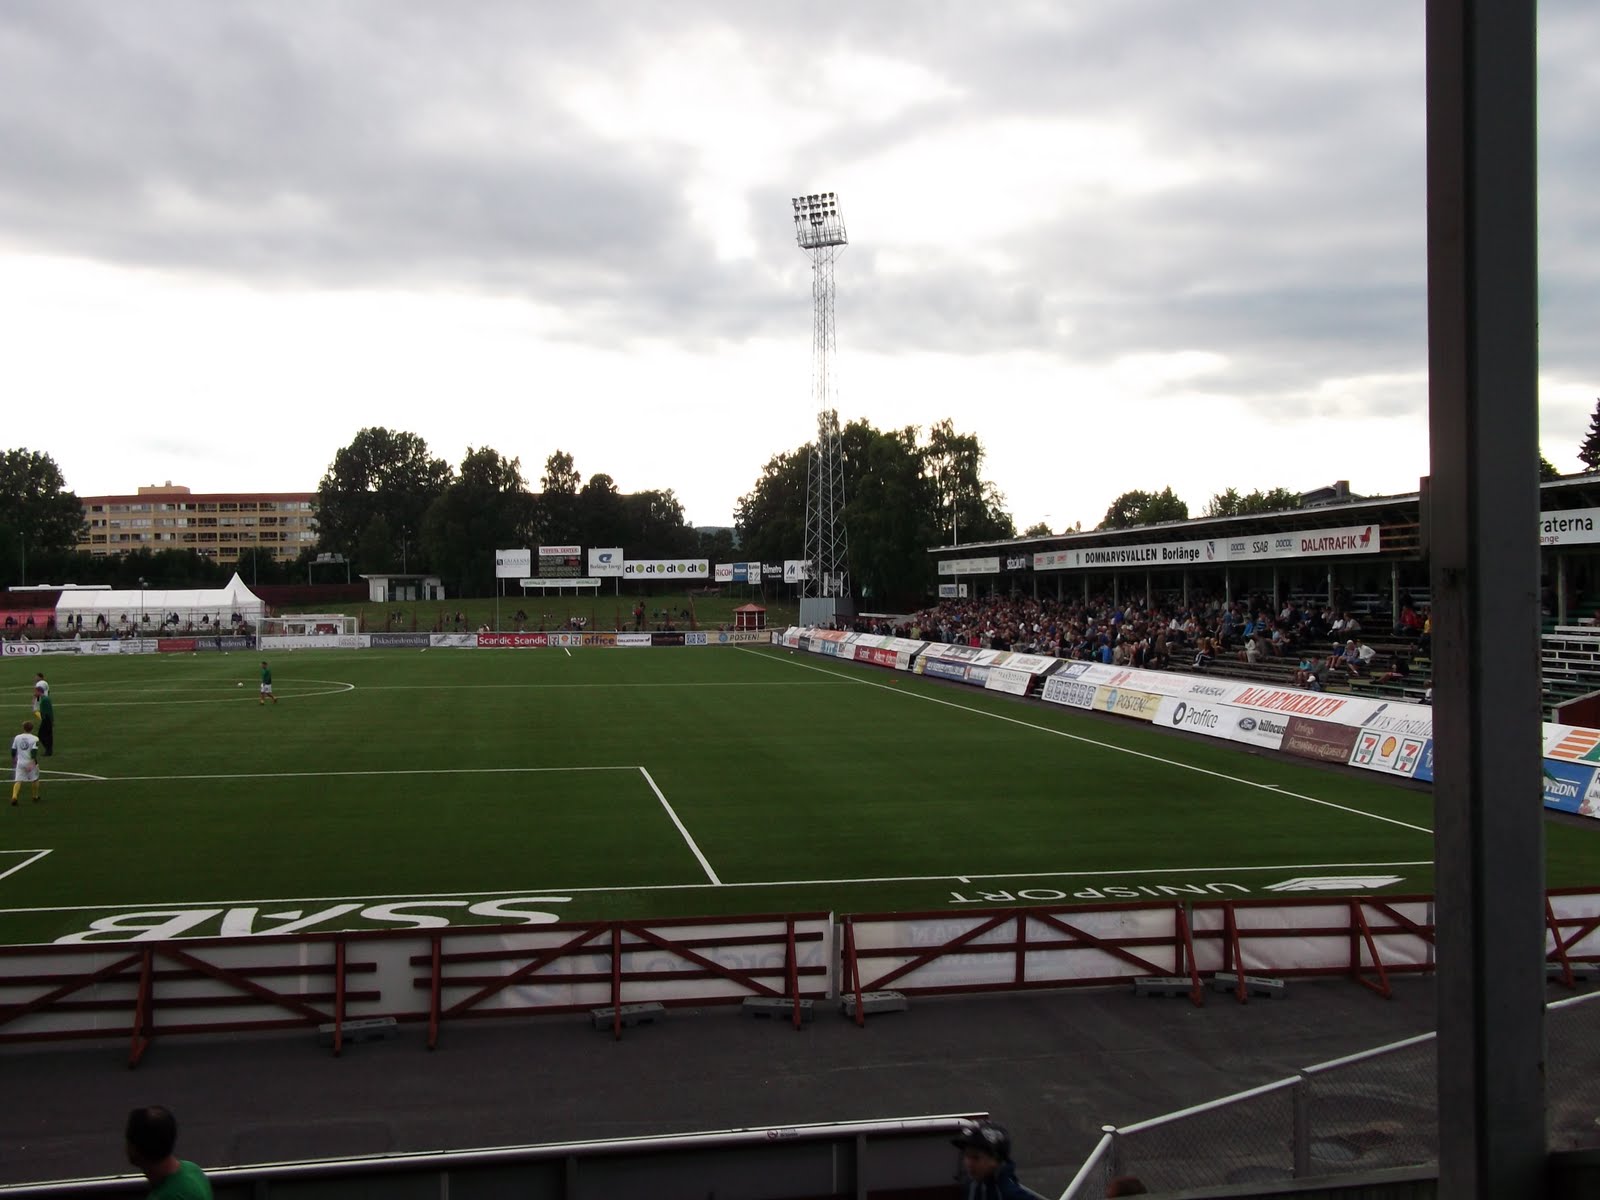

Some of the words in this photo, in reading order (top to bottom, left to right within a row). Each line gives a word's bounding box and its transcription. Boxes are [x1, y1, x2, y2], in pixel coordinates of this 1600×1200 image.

[1301, 535, 1357, 552] DALATRAFIK
[1085, 548, 1157, 563] DOMNARVSVALLEN
[1162, 546, 1200, 562] Borlänge
[715, 568, 733, 577] RICOH
[478, 636, 512, 645] Scandic
[514, 636, 547, 645] Scandic
[1232, 687, 1348, 717] DALA-DEMOKRATEN
[1184, 707, 1219, 729] Proffice
[948, 881, 1251, 904] UNISPORT
[53, 896, 573, 944] SSAB
